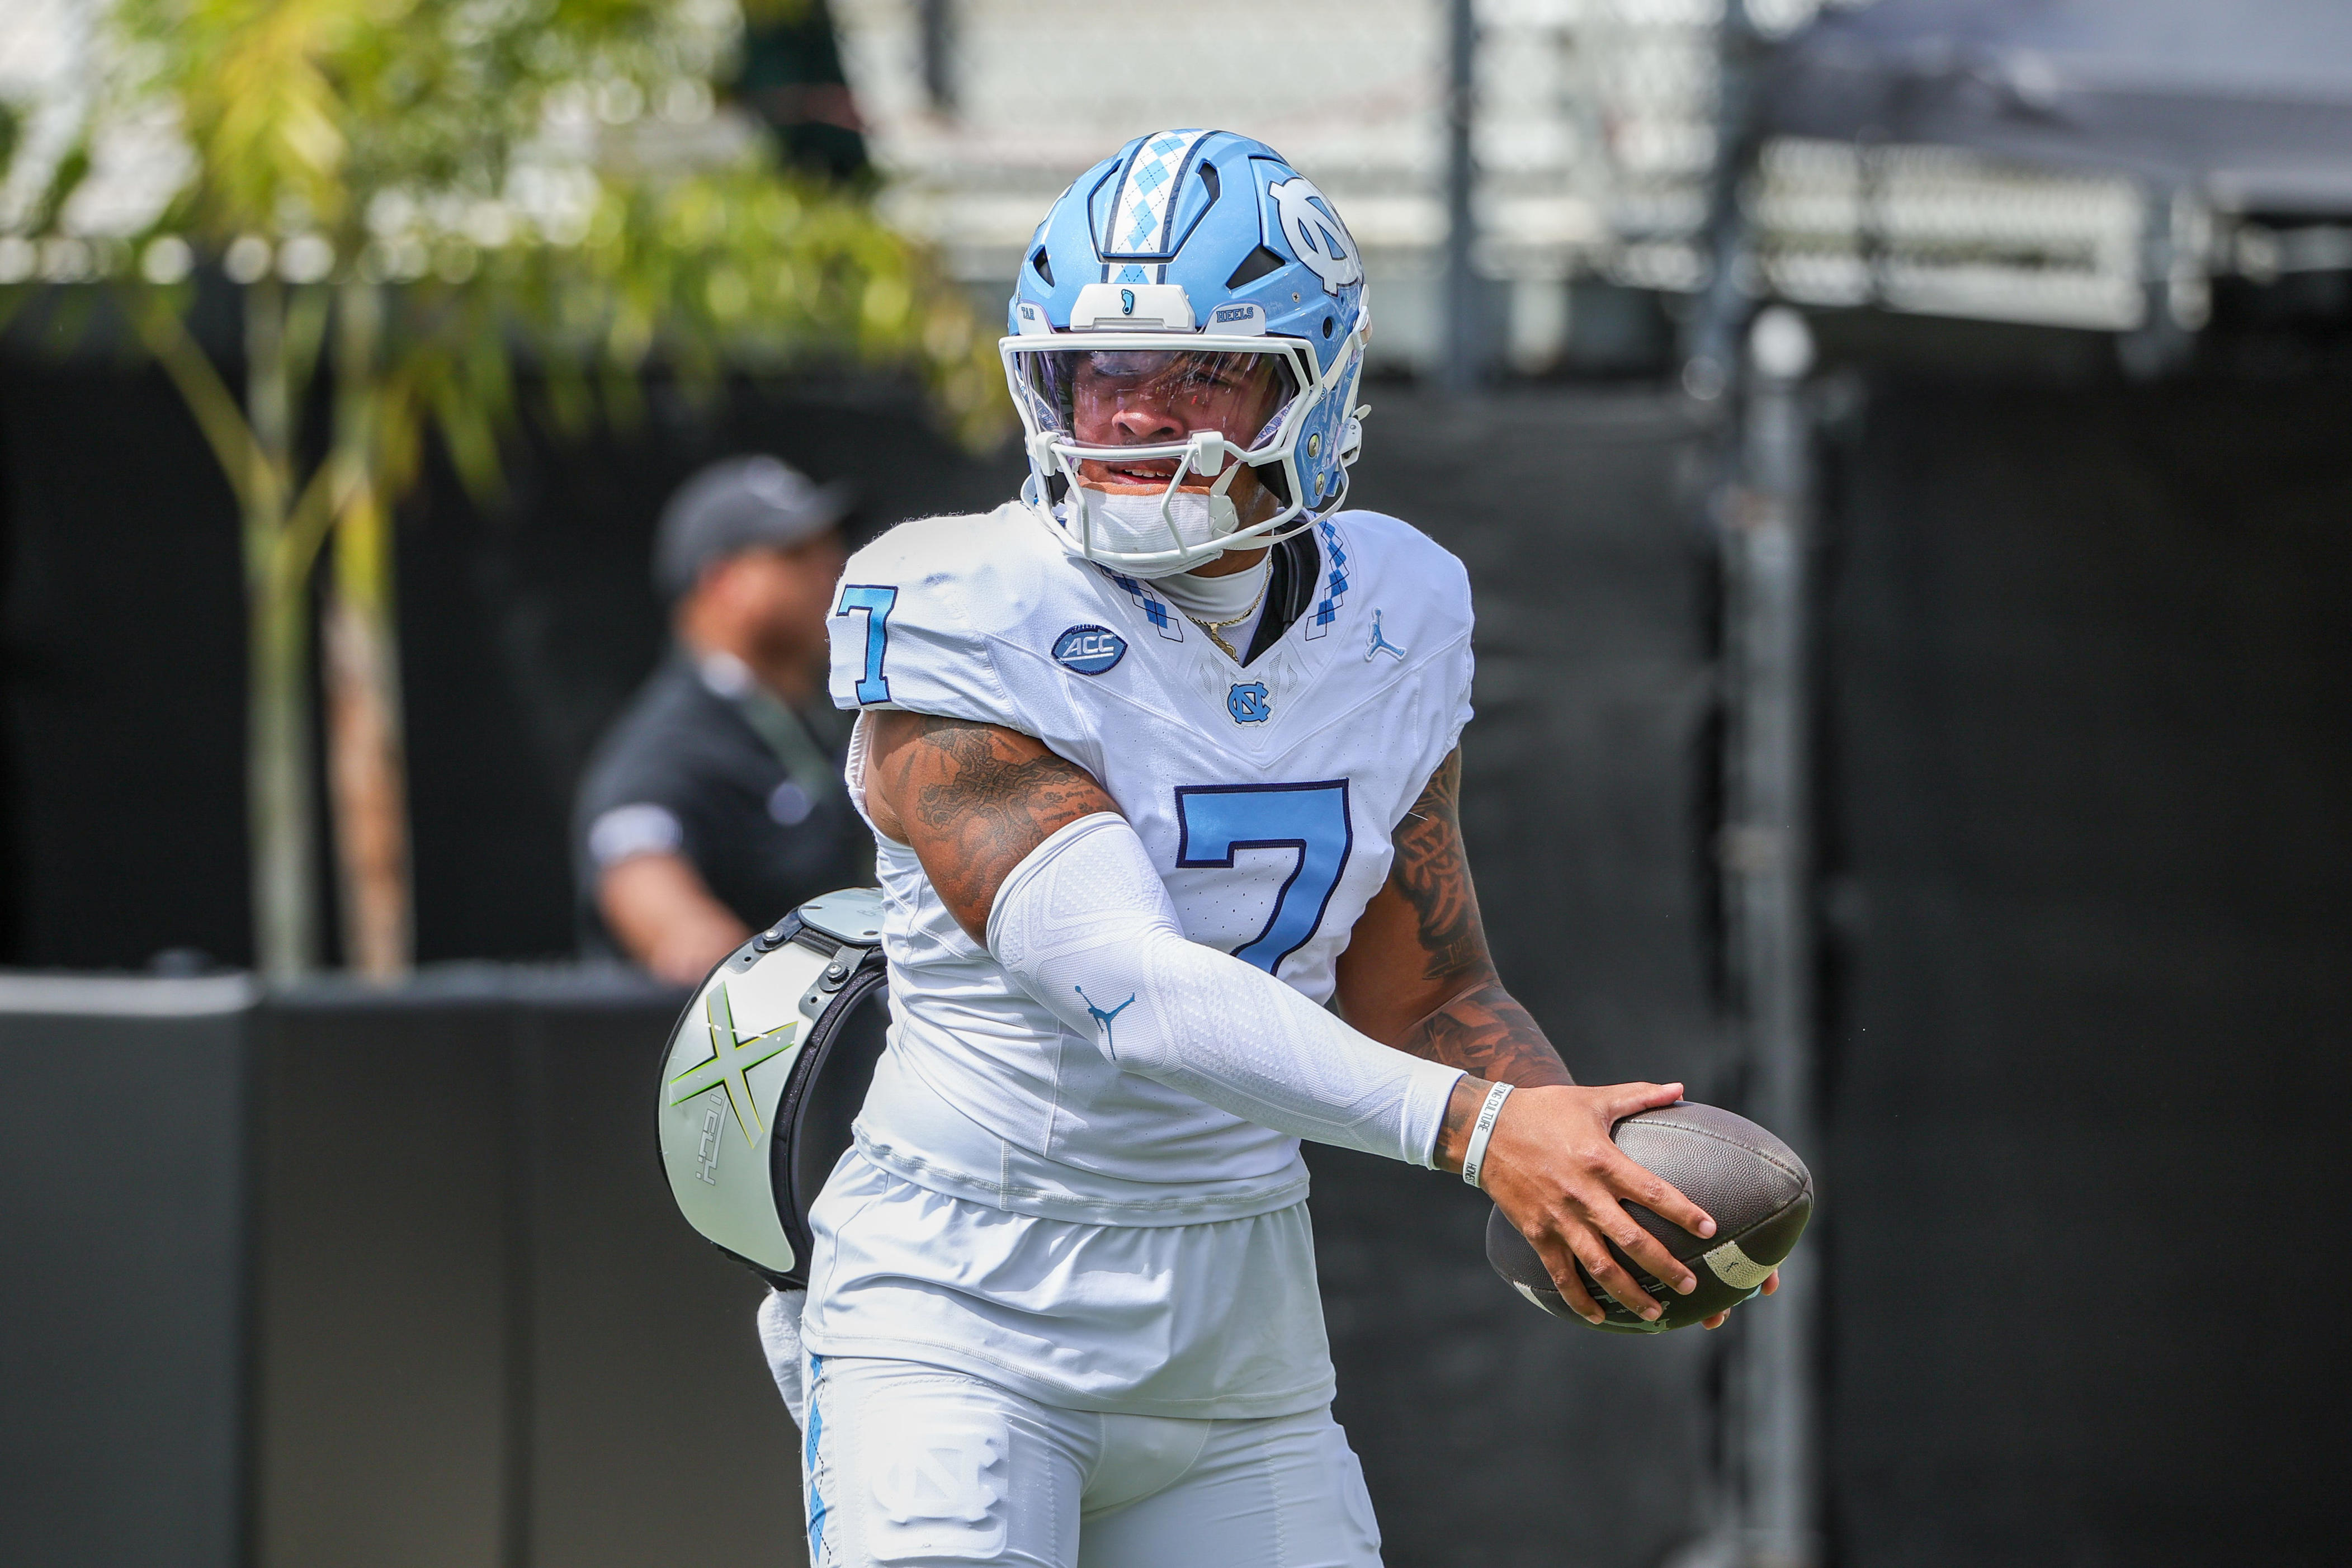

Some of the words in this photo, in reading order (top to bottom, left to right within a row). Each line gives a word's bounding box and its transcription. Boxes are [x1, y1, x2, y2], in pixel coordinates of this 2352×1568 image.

[1021, 306, 1035, 320] TAR
[1216, 306, 1254, 323] HEELS
[1256, 416, 1284, 440] TAR
[836, 584, 898, 705] 7
[1062, 632, 1114, 657] ACC
[1175, 778, 1353, 976] 7
[1478, 1099, 1499, 1132] CULTURE
